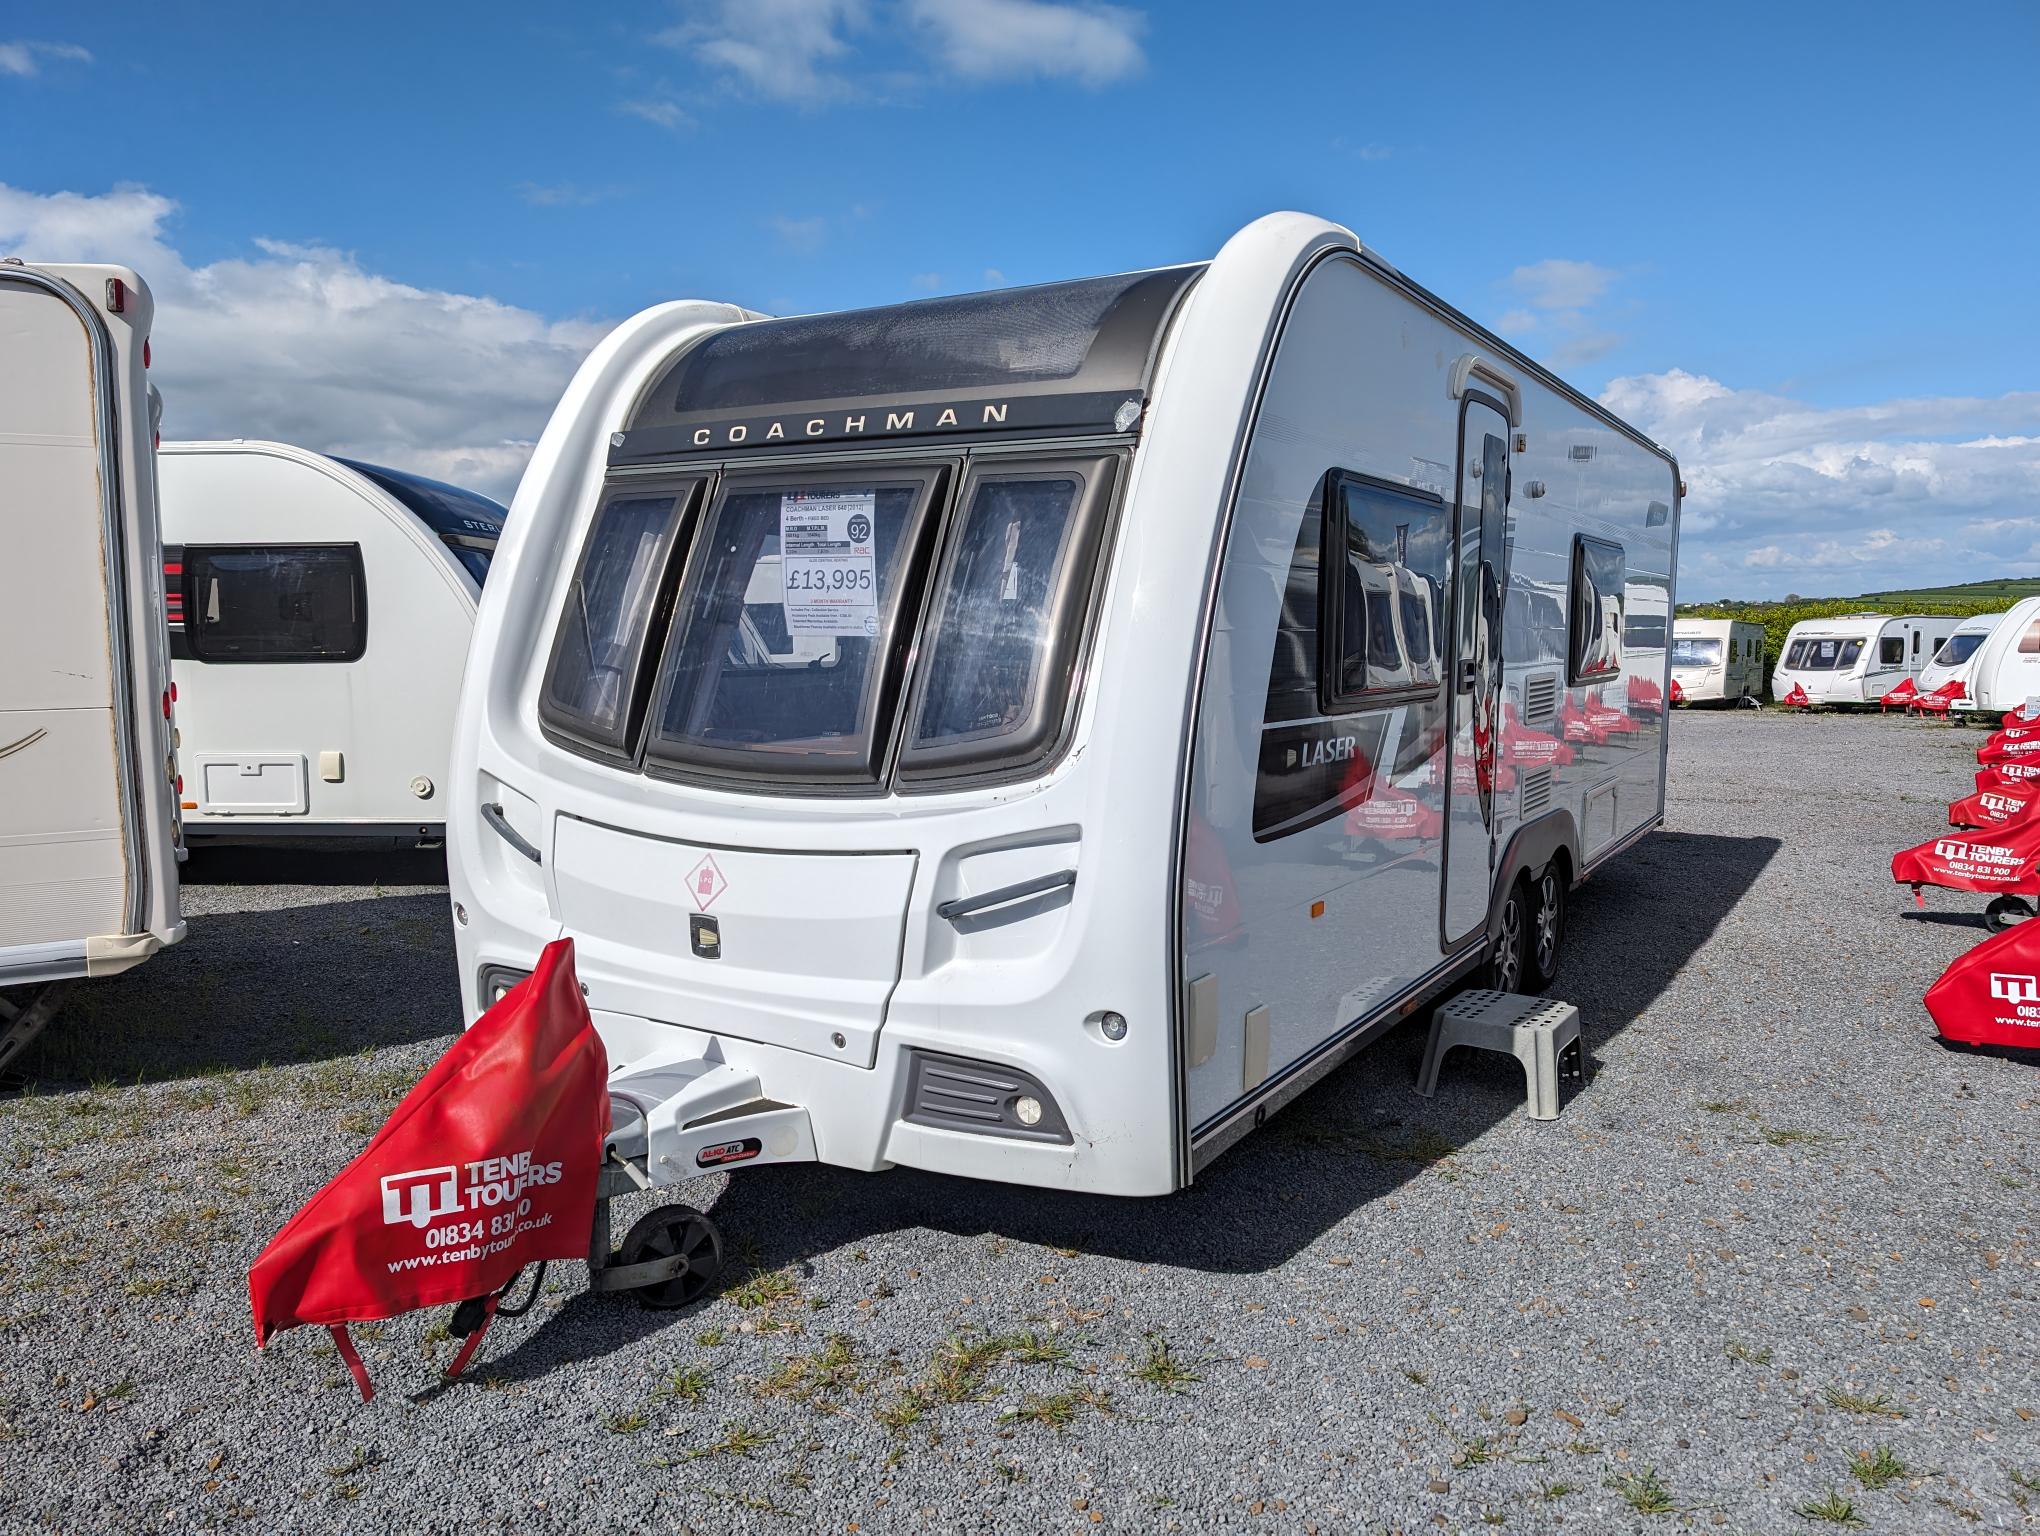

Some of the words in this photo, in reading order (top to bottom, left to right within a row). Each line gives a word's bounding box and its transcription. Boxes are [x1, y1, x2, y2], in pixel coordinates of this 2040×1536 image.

[692, 403, 1009, 446] COACHMAN
[785, 505, 817, 513] COACHMAN
[851, 524, 867, 539] 92
[786, 569, 871, 593] £13,995
[1301, 736, 1356, 768] LASER
[2006, 797, 2027, 807] TEN
[1970, 844, 2014, 857] TENBY
[1968, 852, 2025, 866] TOURERS
[1932, 866, 2021, 882] www.tenbytourers.co.uk
[1949, 861, 1975, 872] 01834
[1976, 865, 1992, 874] 831
[1993, 867, 2010, 876] 900
[725, 1144, 740, 1155] ATC
[464, 1151, 532, 1185] TENB
[425, 1219, 485, 1249] 01834
